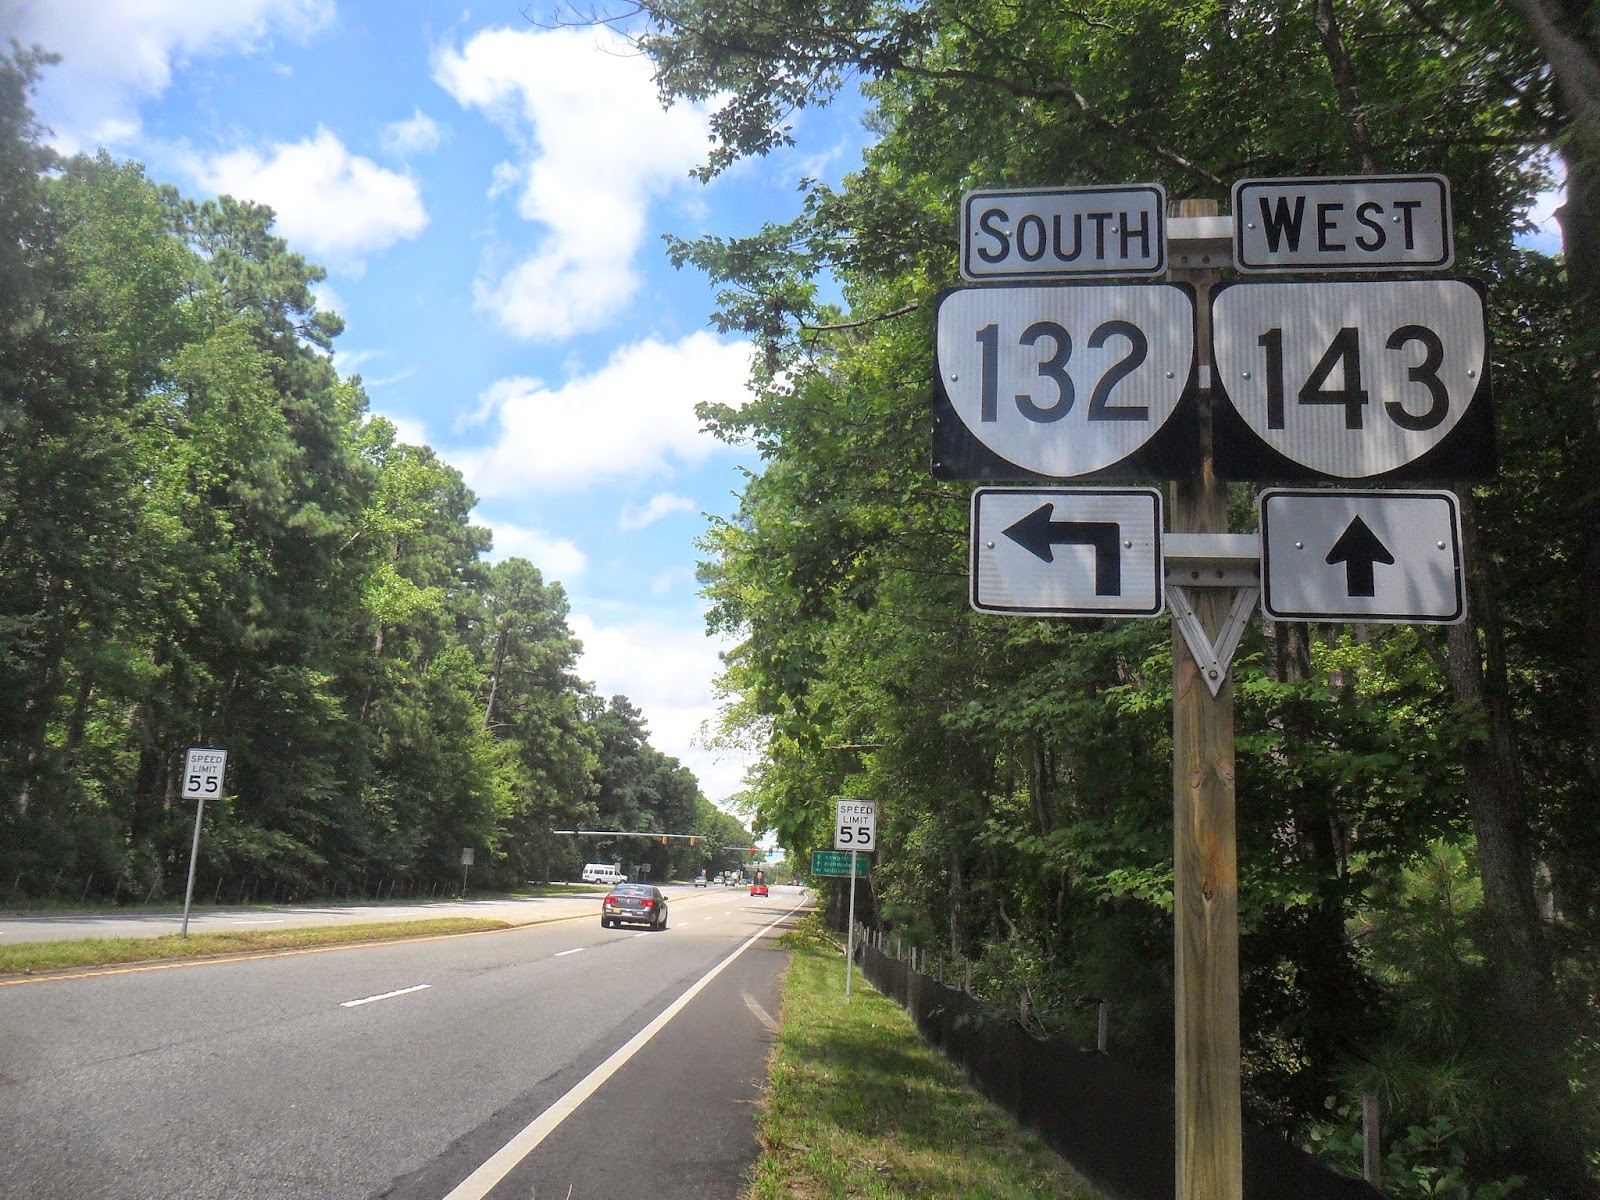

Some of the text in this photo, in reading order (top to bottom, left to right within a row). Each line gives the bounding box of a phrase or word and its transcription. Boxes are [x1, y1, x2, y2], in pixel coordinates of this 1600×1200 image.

[1259, 196, 1422, 253] WEST
[977, 208, 1150, 264] SOUTH
[976, 319, 1149, 423] 132
[1257, 324, 1450, 431] 143
[191, 755, 222, 763] SPEED
[193, 765, 217, 773] LIMIT
[188, 775, 217, 793] 55
[840, 805, 872, 814] SPEED
[843, 816, 868, 824] LIMIT
[840, 826, 870, 844] 55
